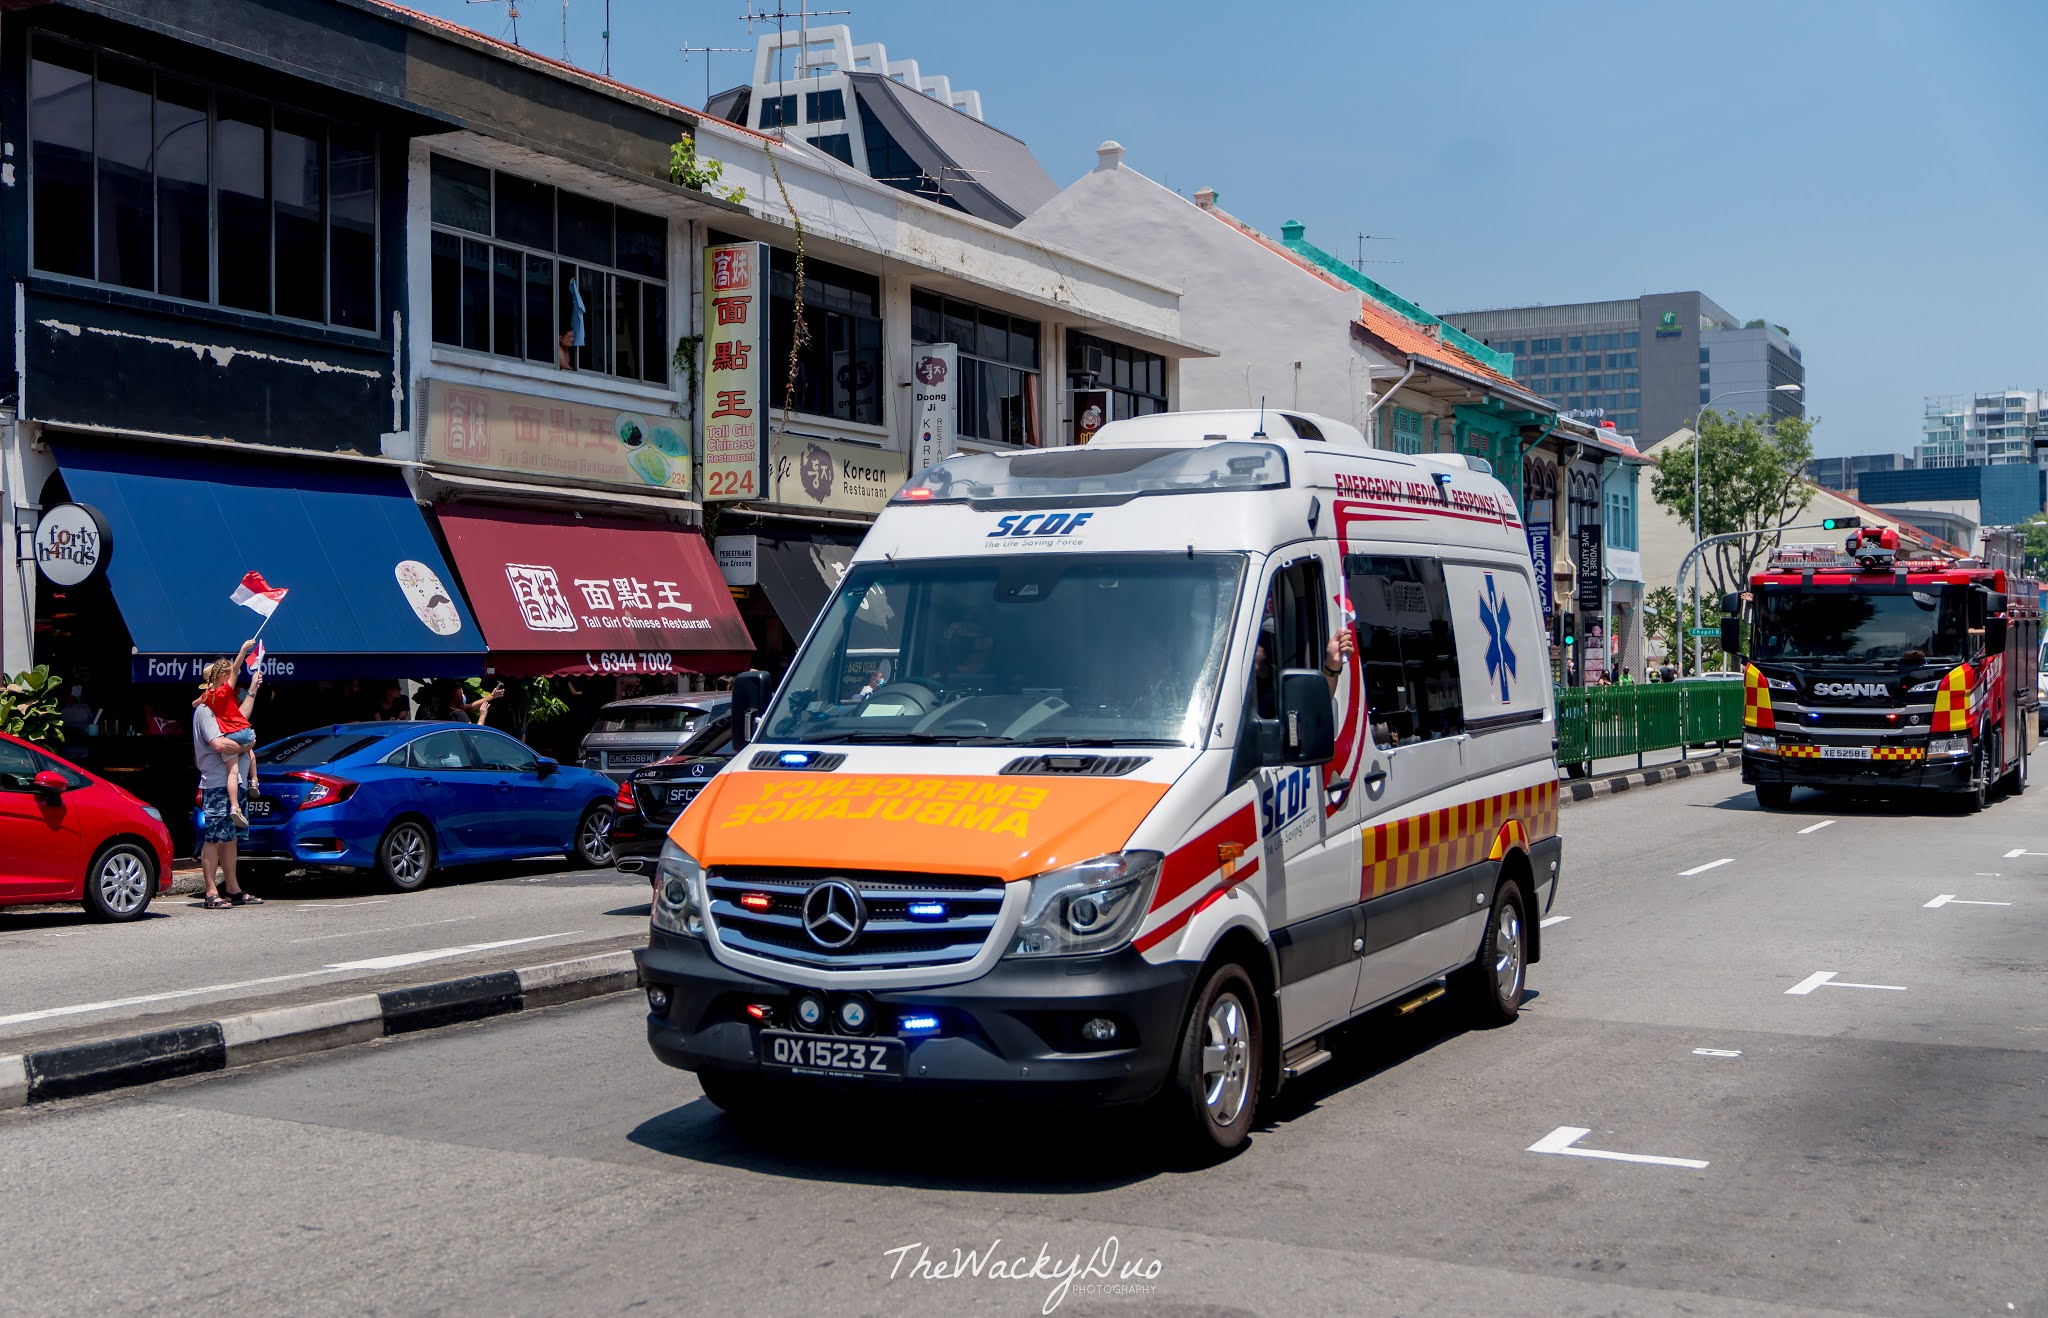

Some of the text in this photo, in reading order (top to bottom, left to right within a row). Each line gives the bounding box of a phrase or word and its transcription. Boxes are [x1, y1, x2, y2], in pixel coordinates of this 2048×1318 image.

[712, 296, 752, 418] 面點王
[917, 393, 946, 402] Doong
[927, 404, 936, 412] Ji
[706, 423, 755, 438] Tall Girl
[707, 438, 755, 451] Chinese
[501, 449, 628, 475] Tall Girl Chinese Restaurant
[707, 452, 755, 463] Restaurant
[671, 471, 685, 485] 224
[843, 459, 886, 483] Korean
[709, 470, 754, 495] 224
[843, 481, 887, 499] Restaurant
[1334, 473, 1402, 503] EMERGENCY
[1451, 489, 1496, 516] RESPONSE
[986, 512, 1095, 538] SCDF
[48, 524, 99, 552] forty
[984, 538, 1083, 549] The Life Saving Force
[574, 576, 692, 612] 面點王
[581, 615, 711, 629] Tall Girl Chinese Restaurant
[148, 658, 187, 680] Forty
[601, 653, 672, 671] 6344 7002
[1814, 682, 1890, 697] SCANIA
[1262, 766, 1311, 838] SCDF
[774, 1038, 887, 1071] QX1523Z
